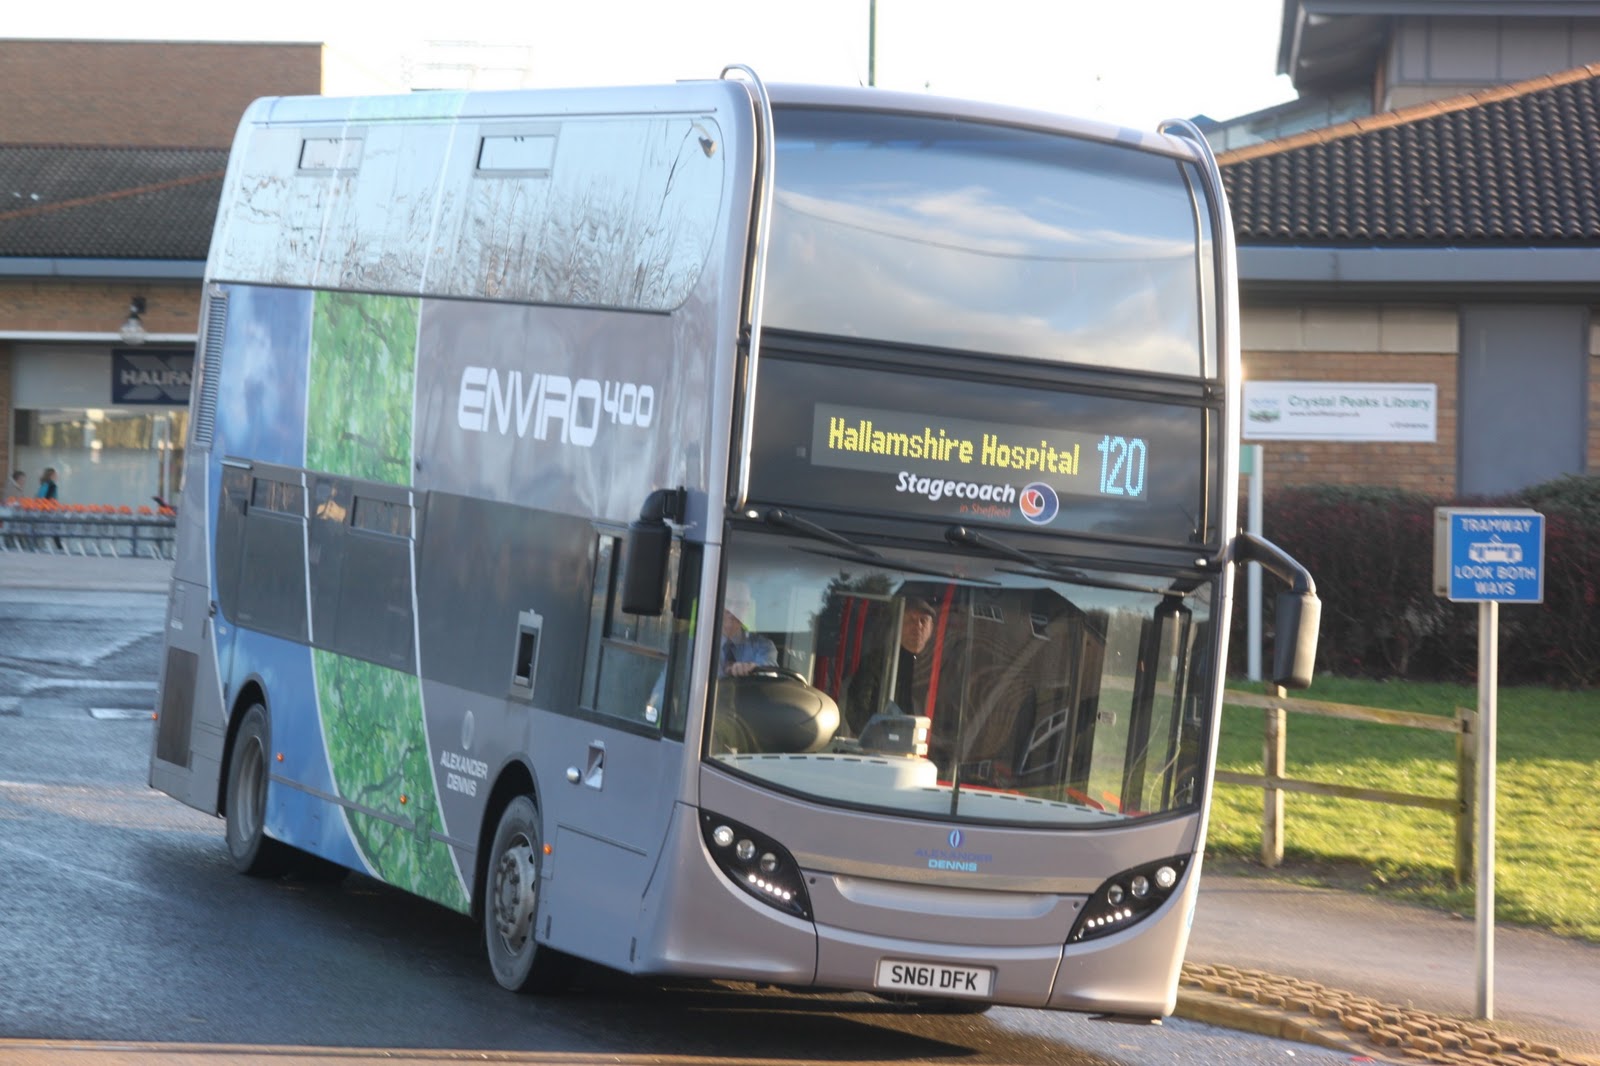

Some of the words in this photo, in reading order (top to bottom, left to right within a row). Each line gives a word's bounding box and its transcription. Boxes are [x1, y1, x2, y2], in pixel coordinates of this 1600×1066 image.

[121, 369, 192, 385] HALIFA
[458, 366, 601, 447] ENVIRO
[603, 380, 655, 428] 400
[1288, 395, 1335, 410] Crystal
[1339, 395, 1379, 408] Peaks
[1383, 396, 1431, 411] Library
[828, 416, 974, 464] Hallamshire
[981, 433, 1080, 476] Hospital
[1097, 434, 1147, 497] 120
[895, 471, 1016, 503] Stagecoach
[1461, 518, 1533, 533] TRAMWAY
[1454, 565, 1495, 580] LOOK
[1497, 566, 1537, 580] BOTH
[1474, 581, 1516, 596] WAYS
[440, 750, 488, 780] ALEXANDER
[446, 773, 477, 797] DENNIS
[914, 848, 993, 862] ALEXANDER
[928, 859, 977, 872] DENNIS
